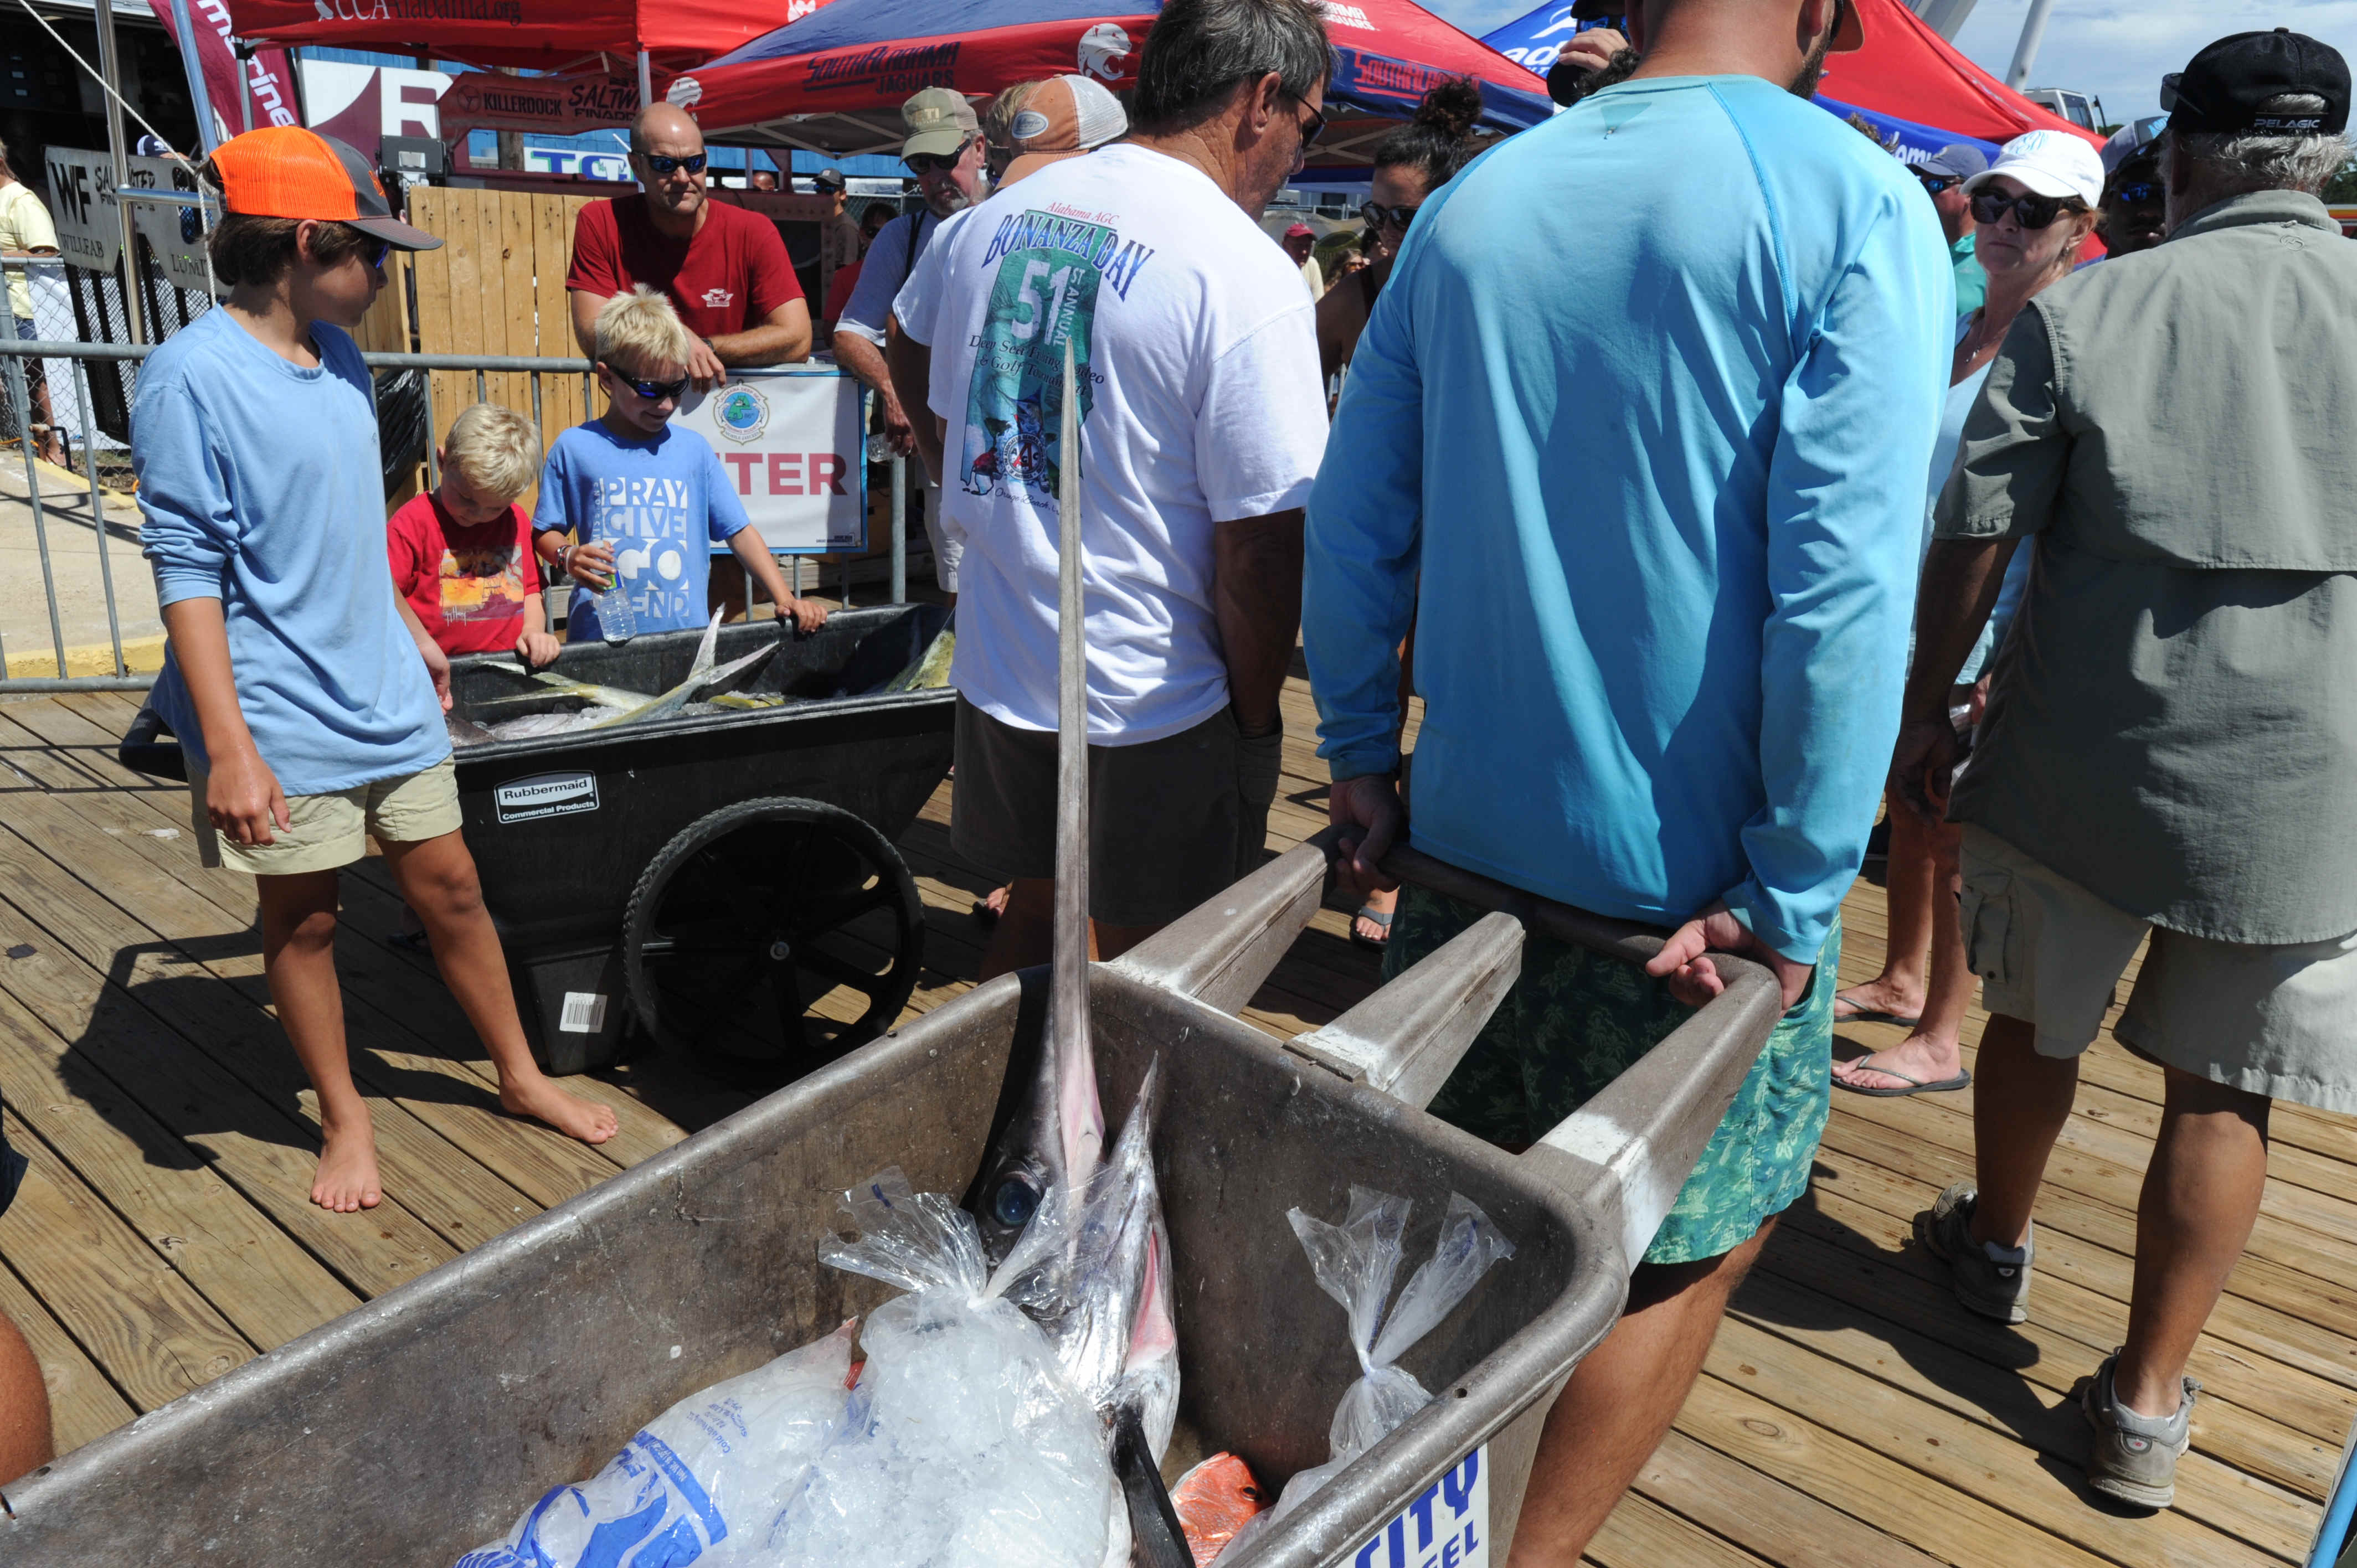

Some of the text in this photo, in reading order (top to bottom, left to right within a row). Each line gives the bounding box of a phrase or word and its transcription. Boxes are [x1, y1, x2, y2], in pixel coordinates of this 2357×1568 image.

[485, 92, 562, 116] KILLERDOCK
[568, 84, 641, 111] SALTW
[2253, 118, 2321, 129] PELAGIC
[50, 161, 91, 225] WF
[1046, 202, 1120, 225] Alabama AGC
[60, 233, 105, 259] WILLFAB
[981, 214, 1155, 303] BONANZA DAY
[1011, 259, 1072, 345] 51
[1053, 286, 1080, 346] ANNUAL
[969, 334, 996, 351] Deep
[999, 340, 1025, 356] Sea
[1073, 366, 1104, 384] odeo
[980, 354, 989, 366] &
[990, 356, 1025, 376] Golf
[716, 452, 848, 496] TER
[601, 477, 688, 509] PRAY
[602, 507, 688, 539] GIVE
[605, 538, 688, 591] GO
[631, 590, 689, 618] END
[503, 778, 588, 800] Rubbermaid
[502, 801, 595, 821] Commercial Products
